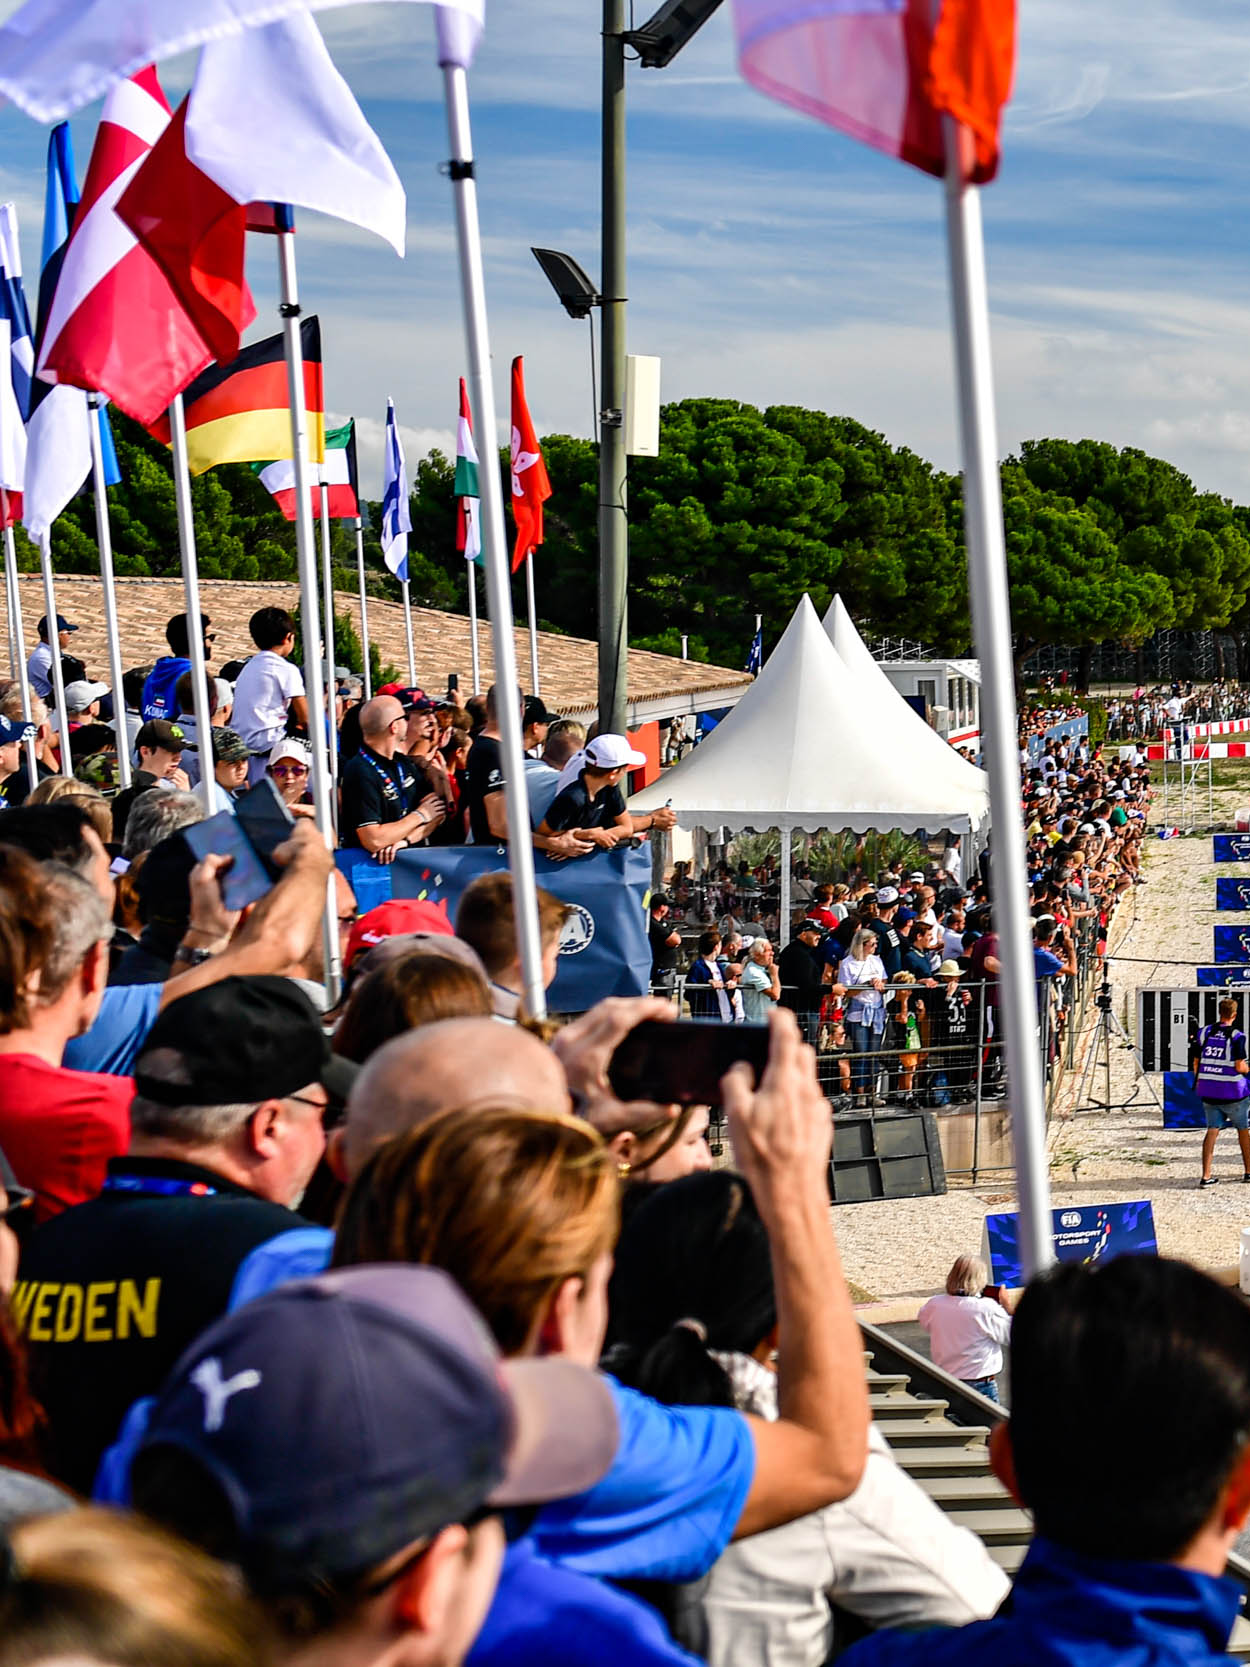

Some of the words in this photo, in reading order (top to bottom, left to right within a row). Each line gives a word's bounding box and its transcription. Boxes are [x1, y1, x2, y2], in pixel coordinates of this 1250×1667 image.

[1173, 1014, 1185, 1024] B1
[1204, 1046, 1225, 1058] 337
[1062, 1213, 1081, 1226] FIA
[1050, 1230, 1102, 1241] OTORSPORT
[1058, 1238, 1090, 1246] GAMES
[11, 1277, 161, 1342] WEDEN
